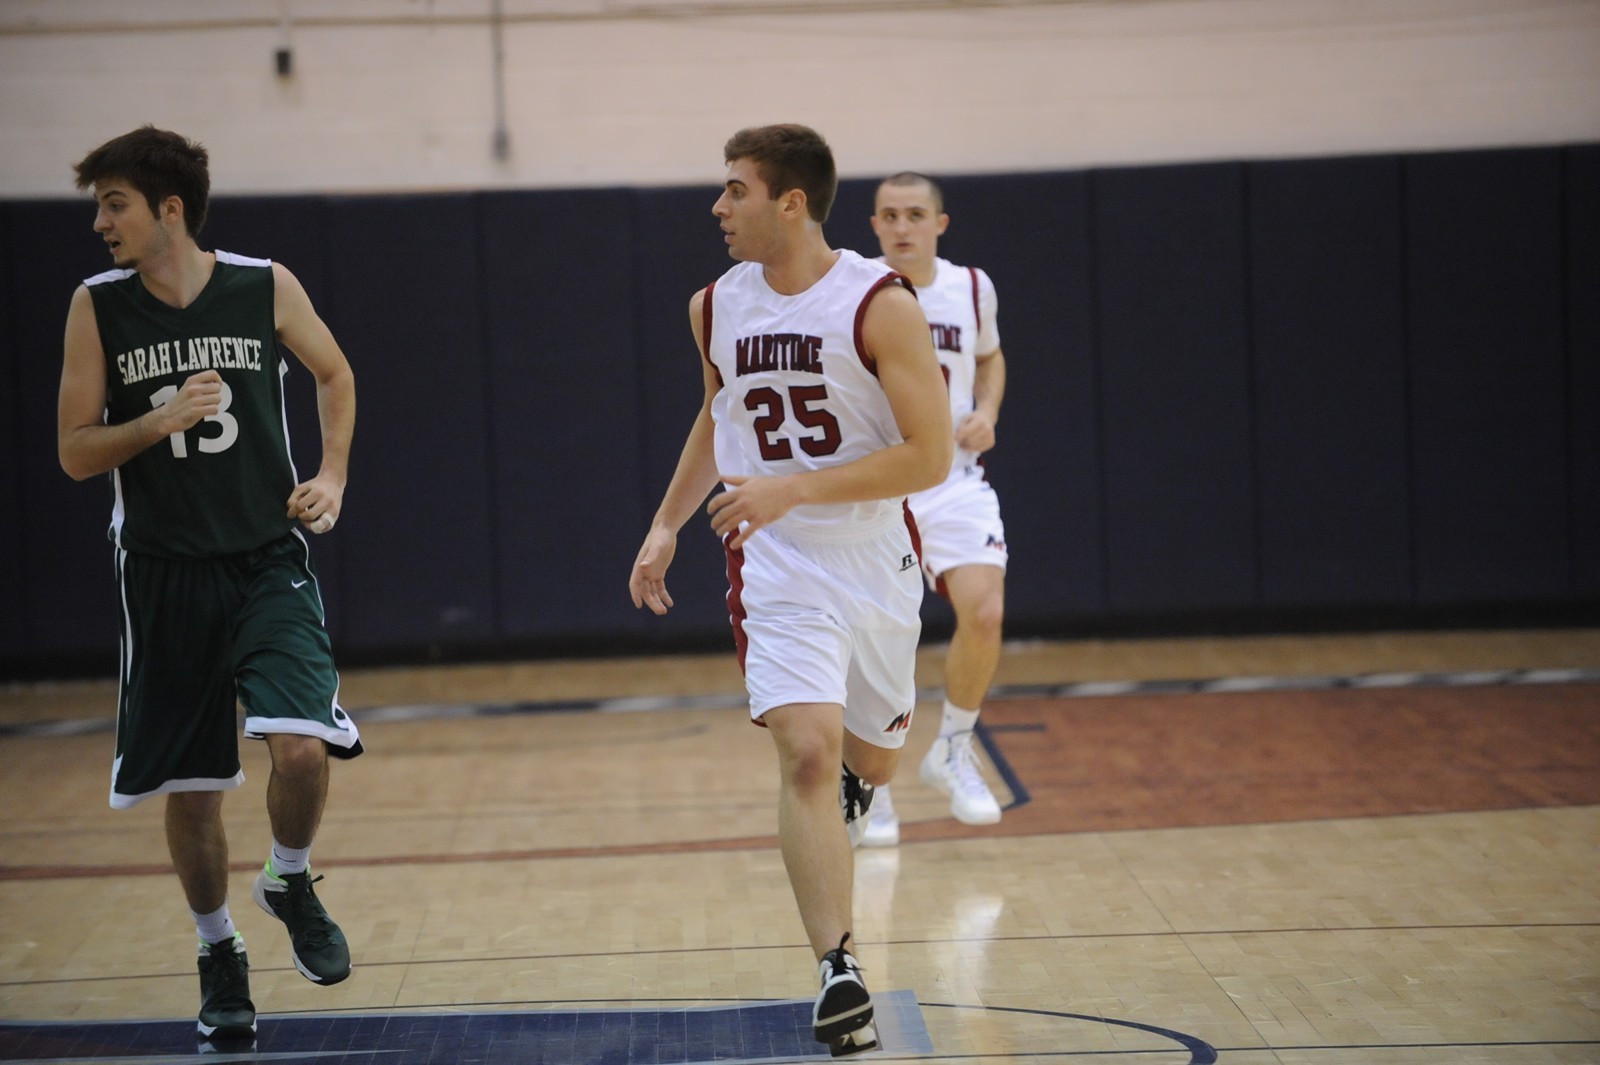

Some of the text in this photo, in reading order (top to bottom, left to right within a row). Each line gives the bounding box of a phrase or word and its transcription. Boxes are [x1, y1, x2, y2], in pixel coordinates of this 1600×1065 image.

[117, 337, 262, 385] SARAH LAWRENCE
[736, 333, 824, 377] MARITIME
[149, 381, 239, 458] 13
[743, 384, 843, 461] 25
